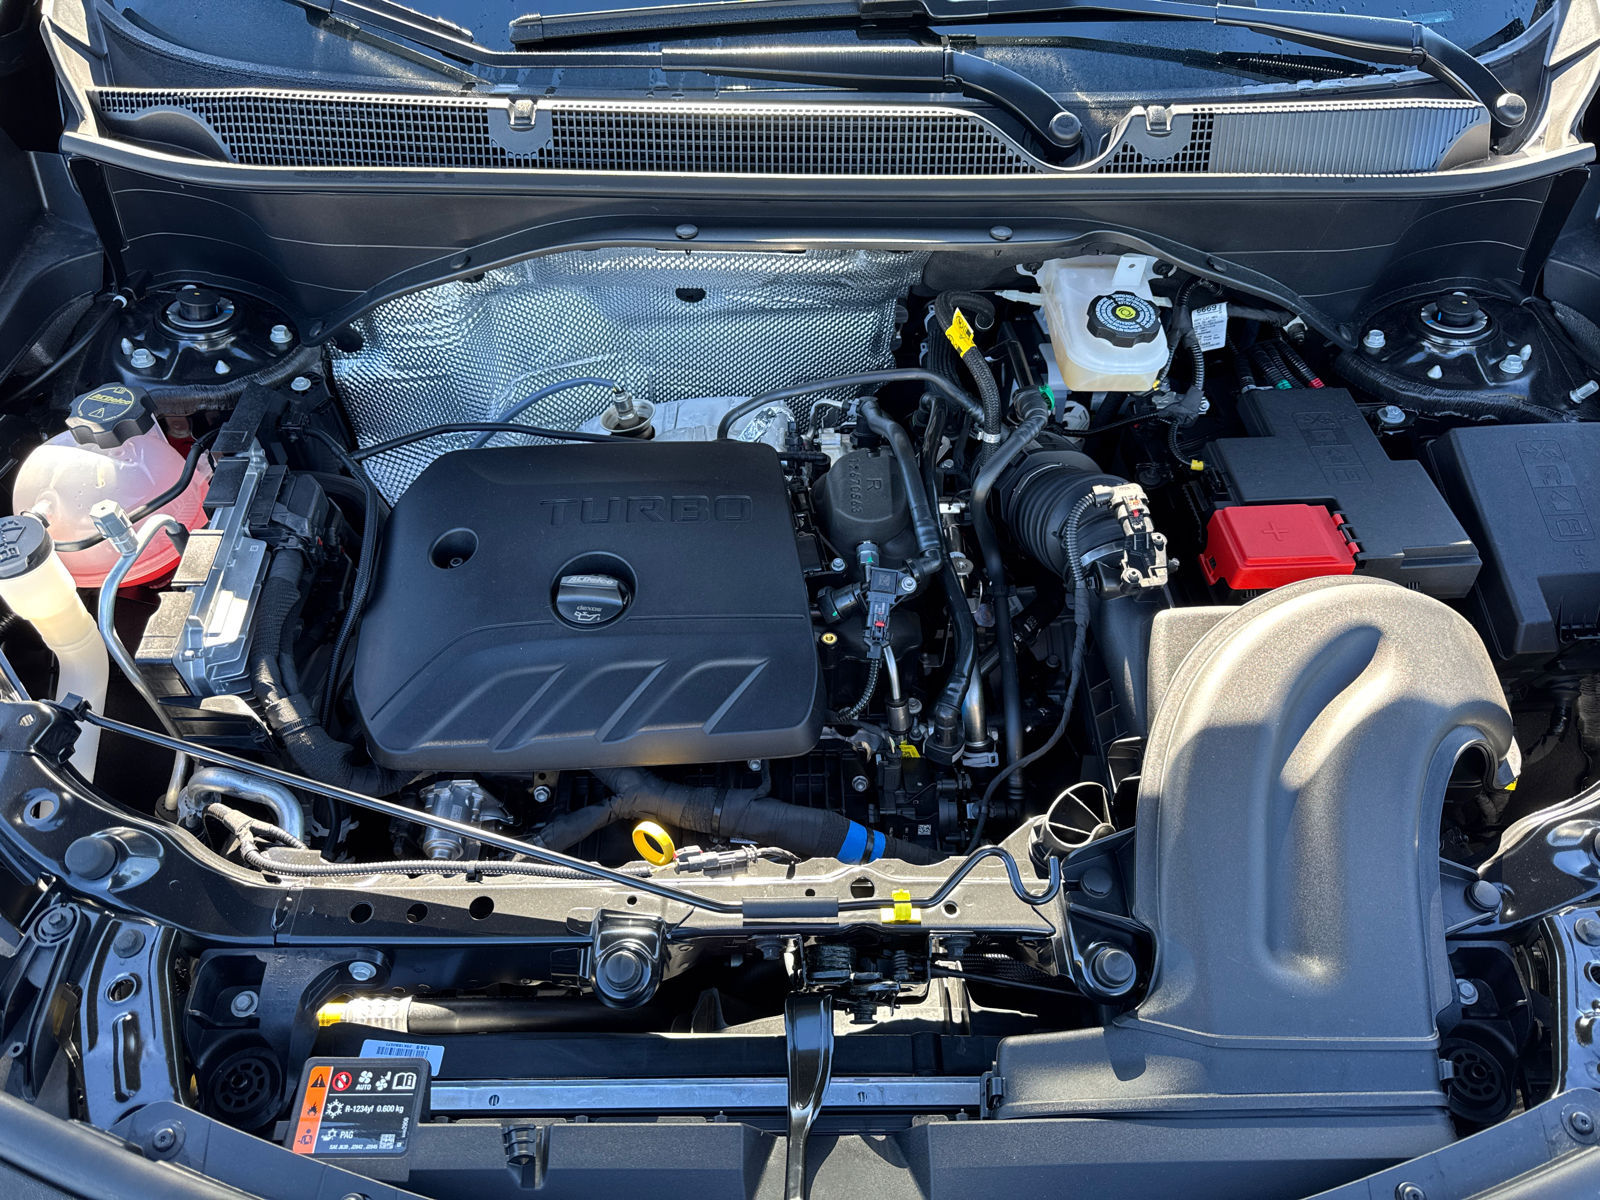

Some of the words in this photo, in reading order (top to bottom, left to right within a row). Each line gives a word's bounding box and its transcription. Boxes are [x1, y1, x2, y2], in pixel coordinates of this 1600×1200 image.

[90, 393, 132, 405] ACDelco
[866, 477, 883, 491] R
[540, 495, 753, 526] TURBO
[566, 576, 614, 585] ACDelco
[355, 1083, 372, 1091] AUTO
[344, 1104, 374, 1113] R-1234yf
[376, 1105, 395, 1113] 0.600
[395, 1105, 404, 1114] kg
[339, 1131, 354, 1139] PAG
